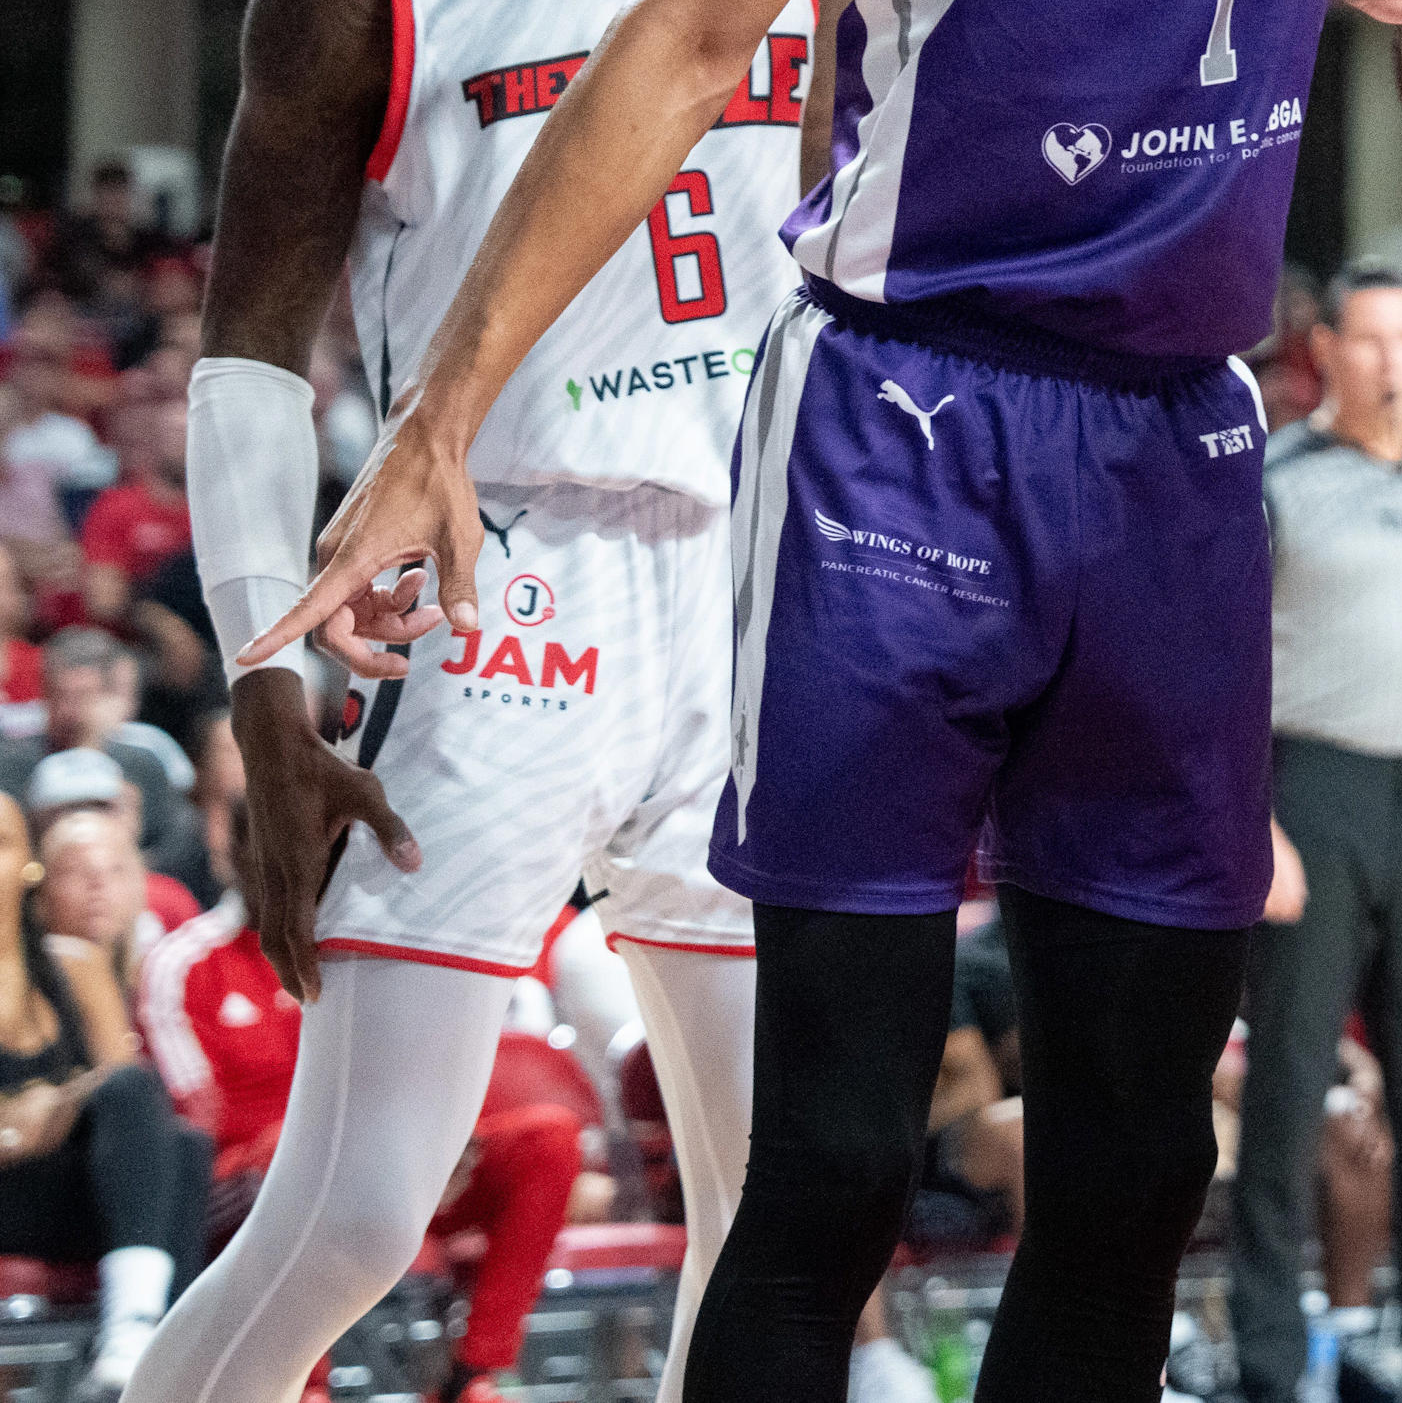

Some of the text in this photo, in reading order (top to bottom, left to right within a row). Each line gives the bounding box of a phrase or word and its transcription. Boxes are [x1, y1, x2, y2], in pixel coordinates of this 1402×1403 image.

[1120, 122, 1216, 160] JOHN
[1229, 117, 1260, 146] E.
[1119, 153, 1203, 174] foundation
[1209, 148, 1233, 165] for
[646, 168, 728, 326] 6
[851, 529, 914, 556] WINGS
[916, 544, 945, 563] OF
[820, 559, 1010, 609] PANCREATIC CANCER RESEARCH
[439, 627, 600, 695] JAM
[462, 686, 569, 711] SPORTS
